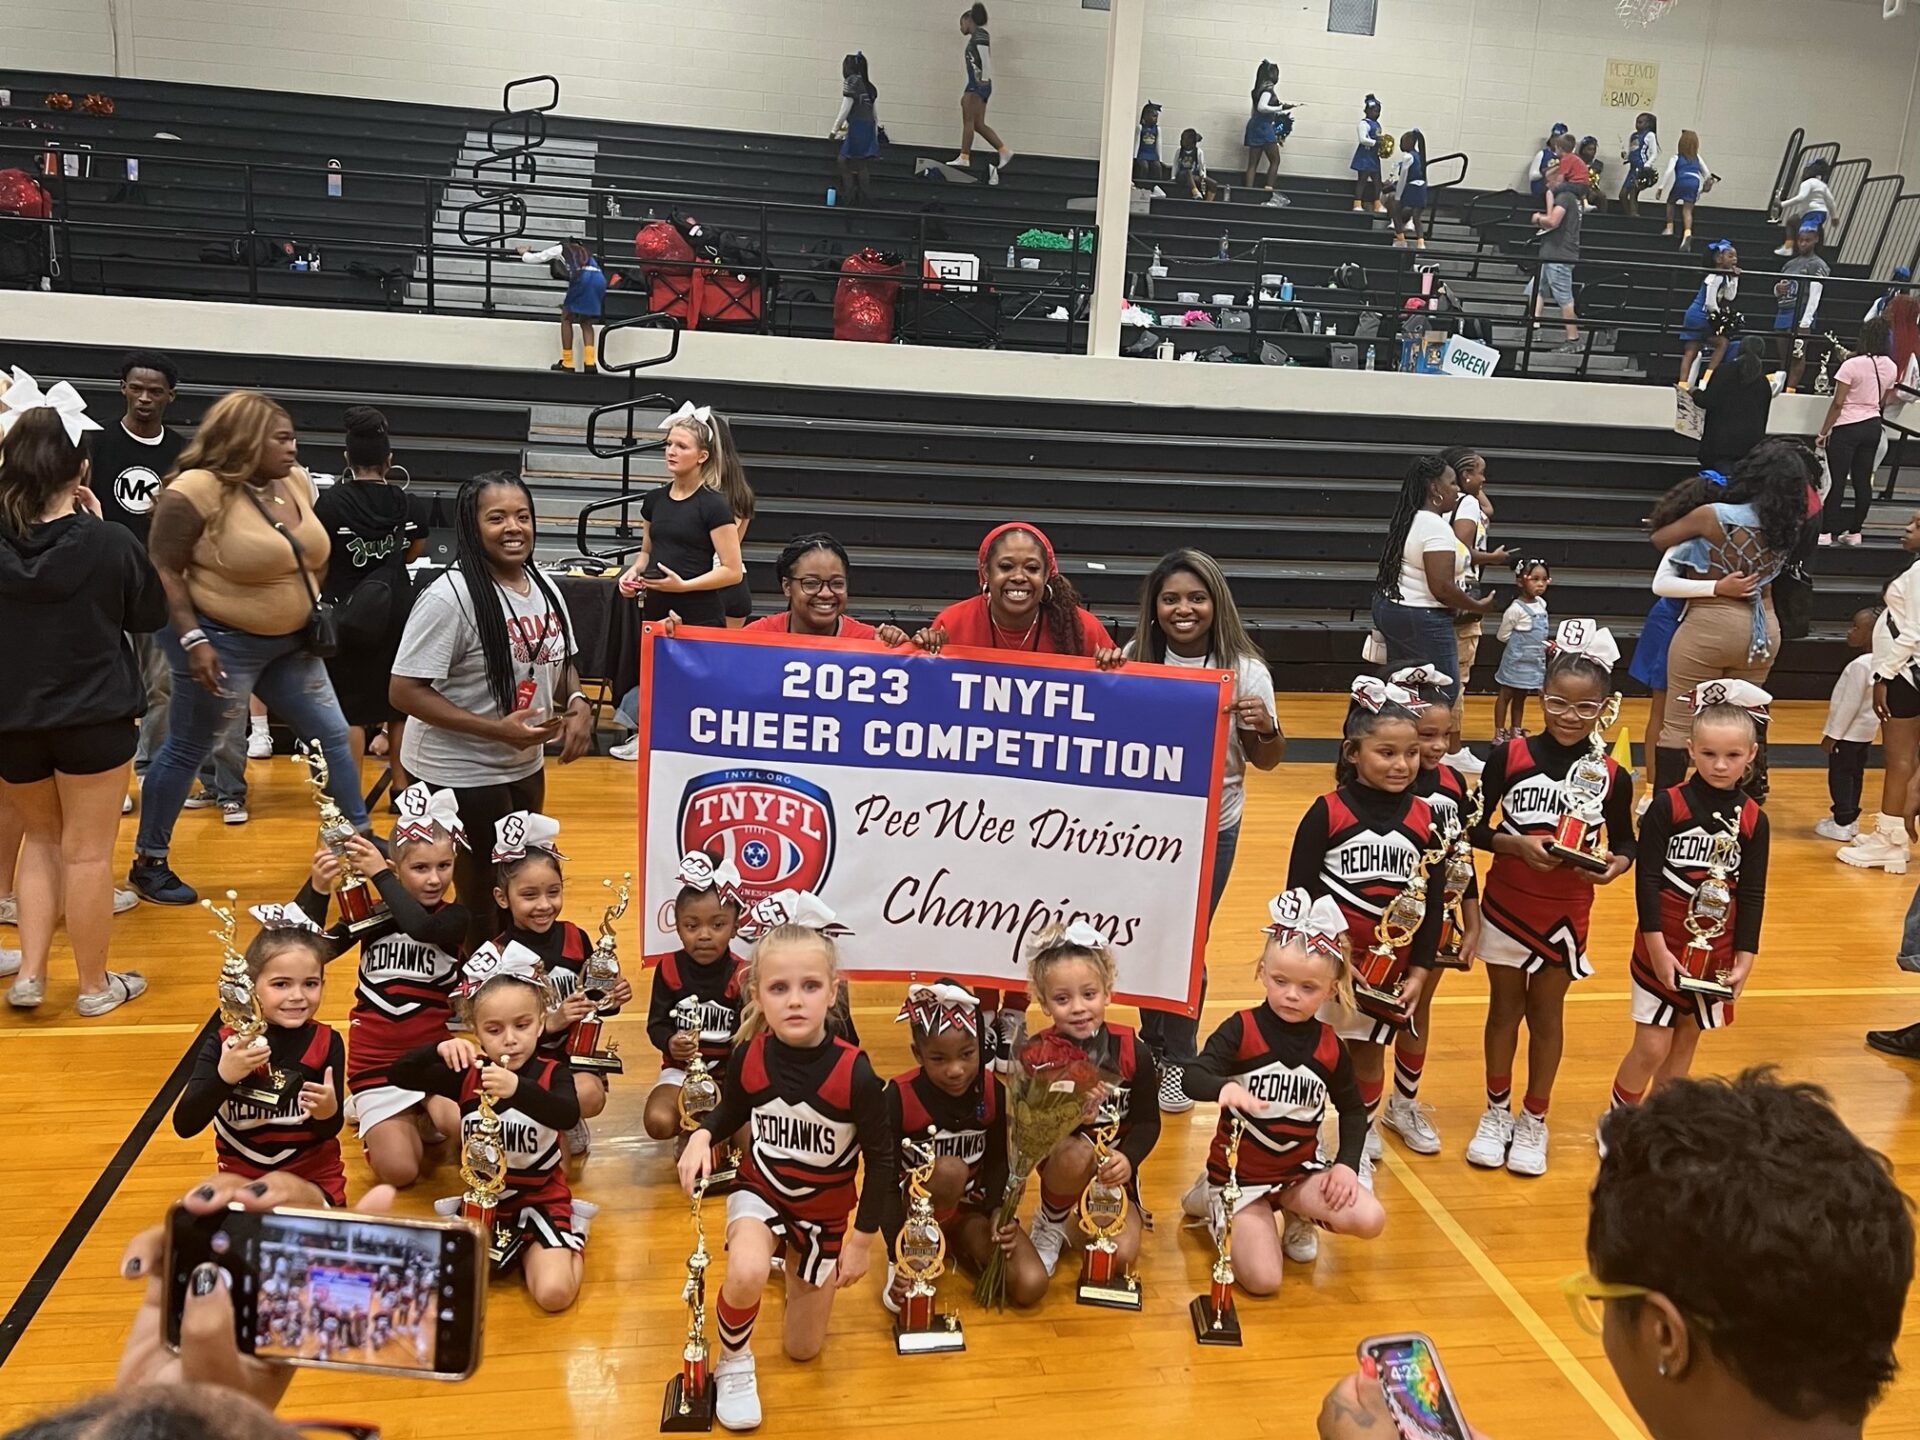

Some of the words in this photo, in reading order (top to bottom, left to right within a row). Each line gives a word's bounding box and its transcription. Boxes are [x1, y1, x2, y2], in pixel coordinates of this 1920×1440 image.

[1610, 91, 1640, 107] BAND
[1451, 348, 1490, 376] GREEN
[119, 477, 160, 505] MK
[782, 661, 910, 705] 2023
[951, 672, 1095, 721] TNYFL
[690, 707, 840, 752] CHEER
[863, 720, 1184, 782] COMPETITION
[725, 771, 792, 784] TNYFL.ORG
[695, 791, 821, 841] TNYFL
[855, 794, 921, 838] Pee
[925, 798, 1015, 844] Wee
[1029, 808, 1183, 863] Division
[1340, 844, 1414, 879] REDHAWKS
[364, 942, 436, 976] REDHAWKS
[1247, 1073, 1324, 1109] REDHAWKS
